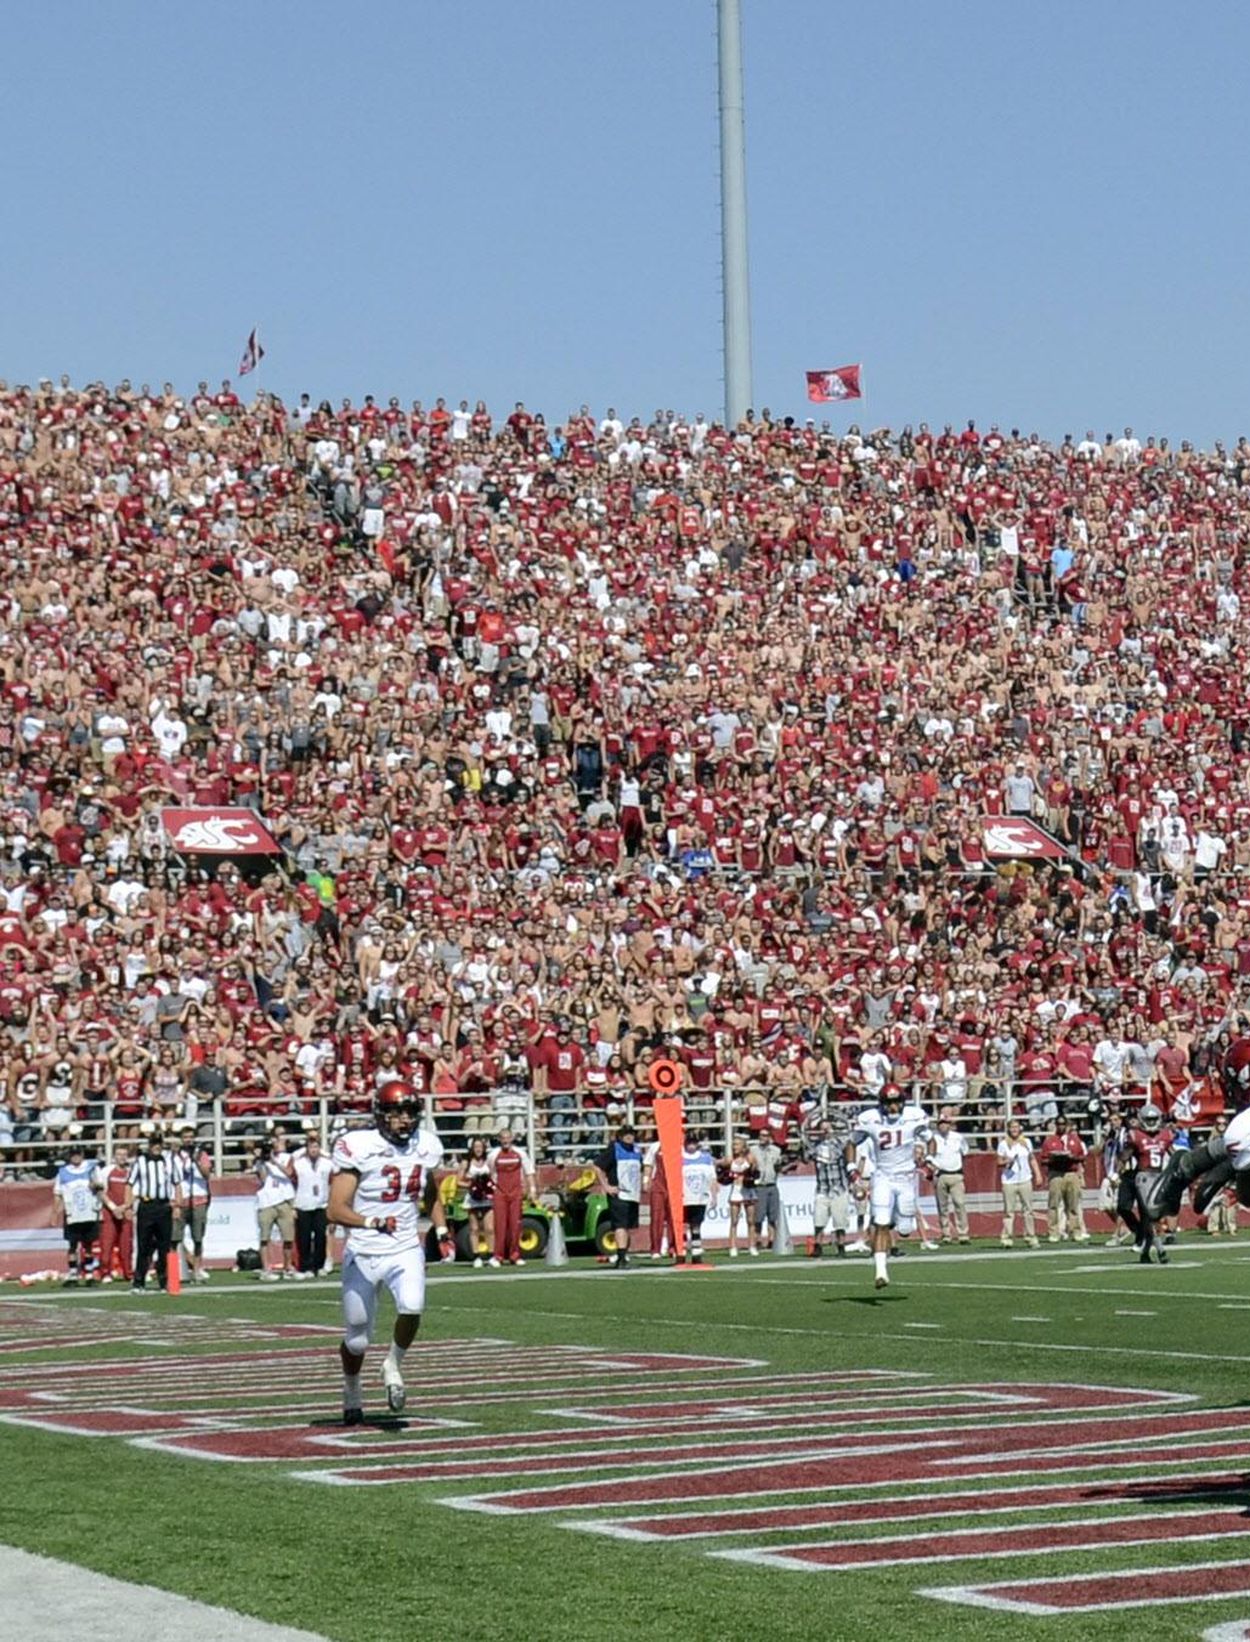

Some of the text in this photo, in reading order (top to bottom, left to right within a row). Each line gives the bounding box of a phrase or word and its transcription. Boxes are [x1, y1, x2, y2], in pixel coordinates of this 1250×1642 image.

[879, 1130, 903, 1150] 21
[1150, 1149, 1161, 1168] 5
[380, 1164, 423, 1202] 34
